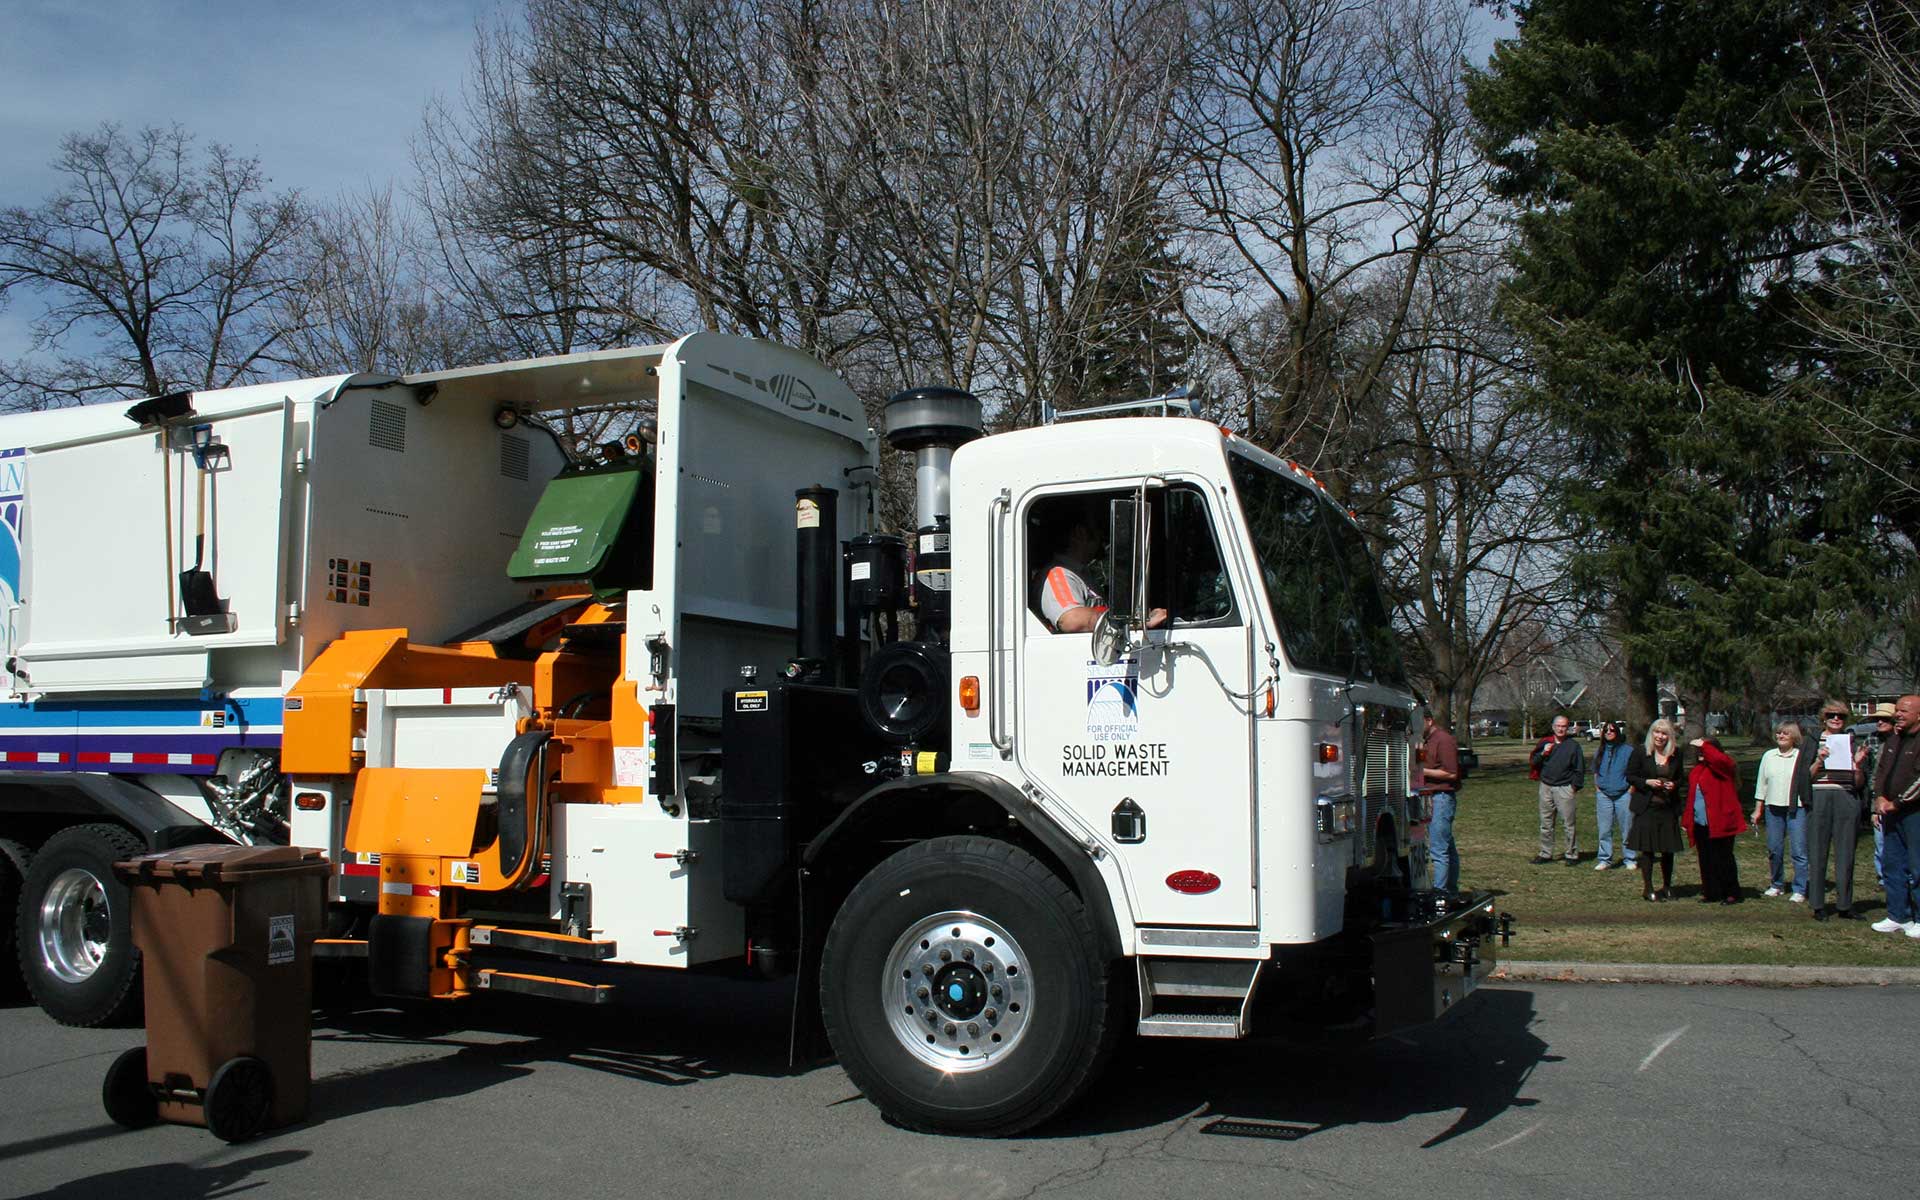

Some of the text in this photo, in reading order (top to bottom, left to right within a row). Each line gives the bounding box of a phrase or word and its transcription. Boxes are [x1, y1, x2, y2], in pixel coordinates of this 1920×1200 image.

[1087, 724, 1138, 733] FOR OFFICIAL
[1094, 732, 1131, 741] USE ONLY
[1062, 743, 1168, 760] SOLID WASTE
[1062, 761, 1170, 776] MANAGEMENT
